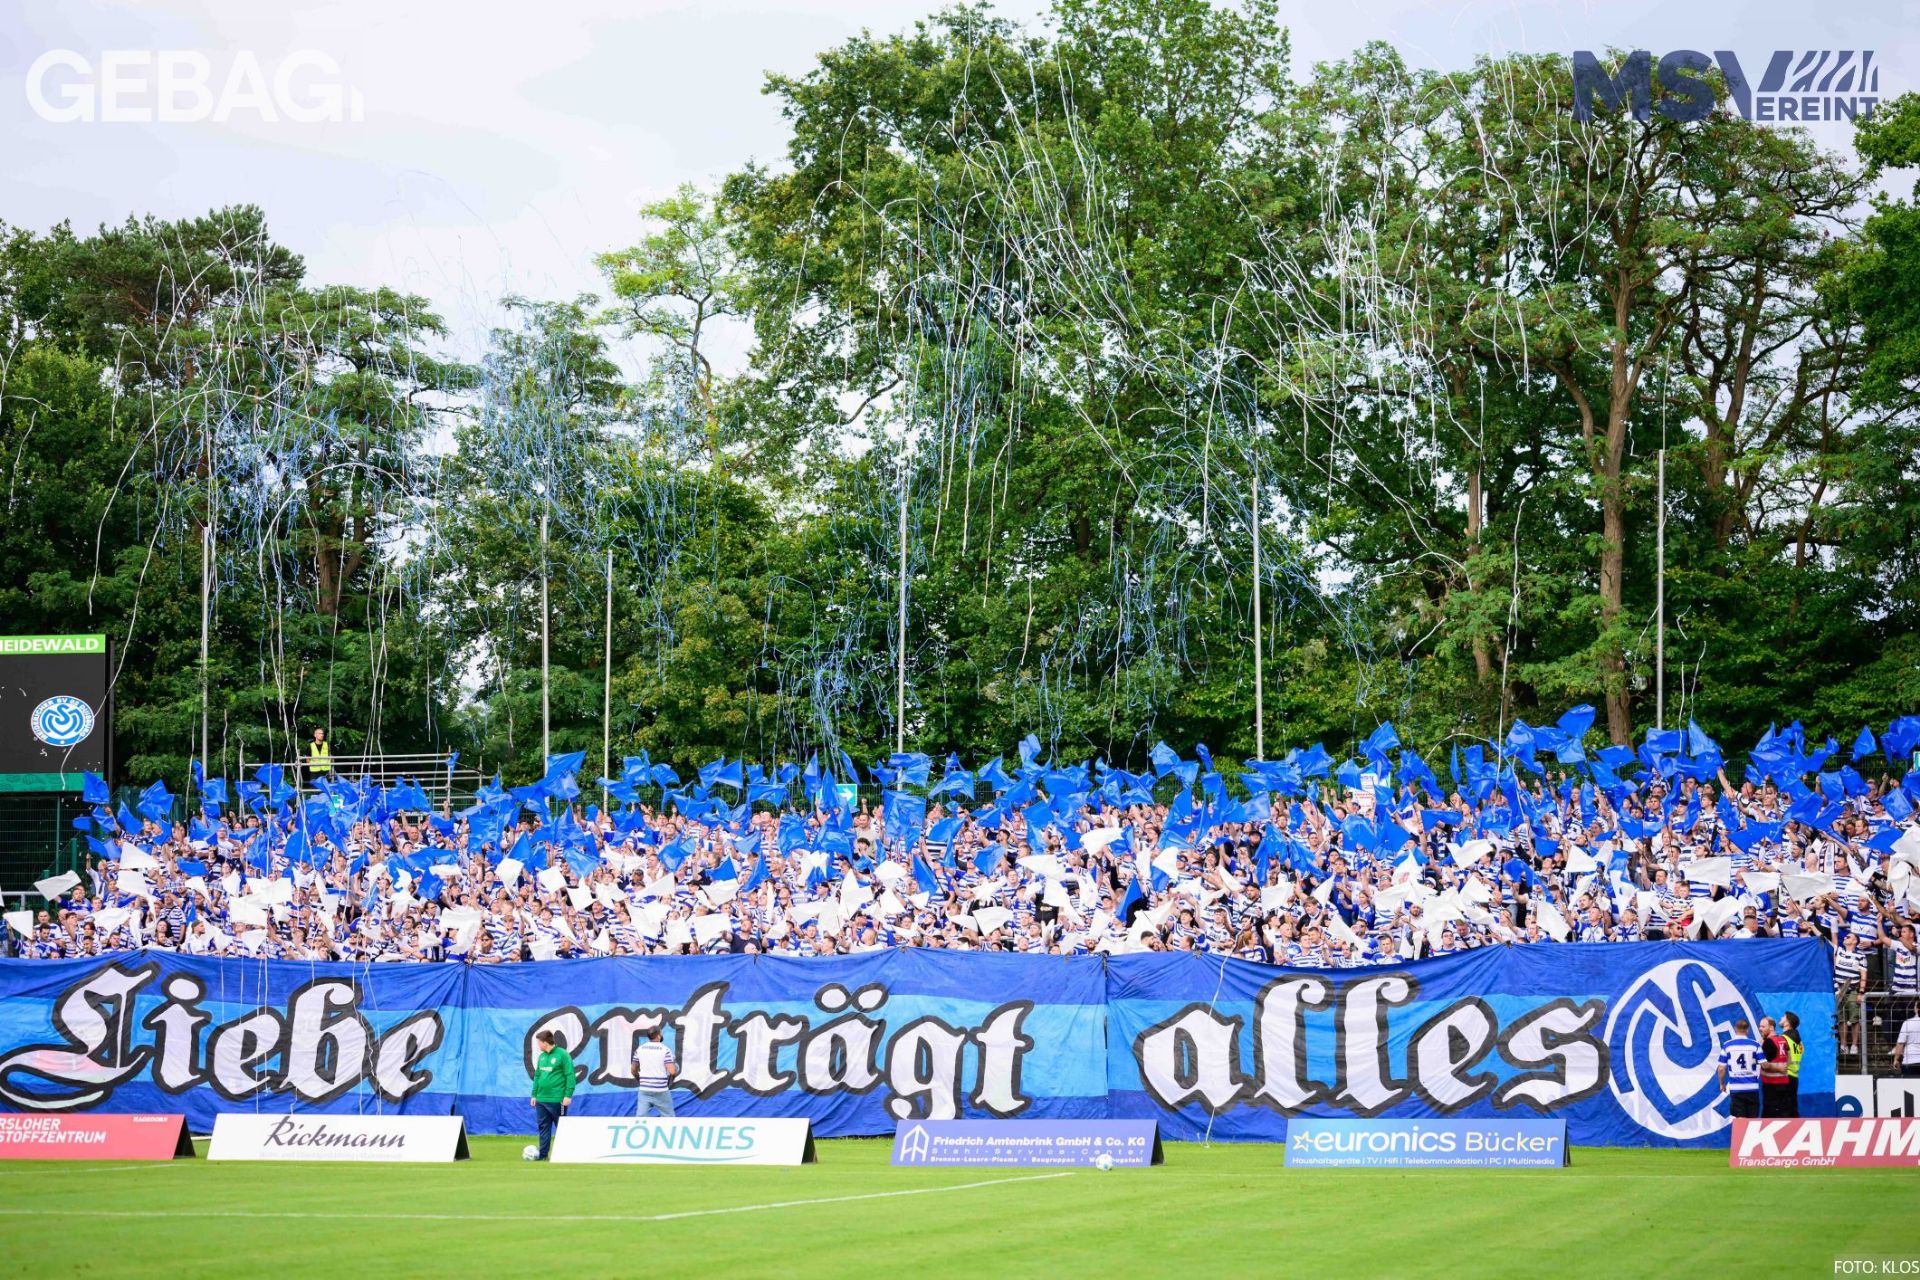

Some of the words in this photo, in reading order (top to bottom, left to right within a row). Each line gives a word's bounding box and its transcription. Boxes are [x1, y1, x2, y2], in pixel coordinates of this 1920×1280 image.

[0, 638, 99, 652] EIDEWALD
[0, 960, 445, 1112] Liebe
[523, 981, 1035, 1119] erträgt
[1133, 972, 1608, 1118] alles
[1736, 1053, 1747, 1069] 4
[263, 1115, 406, 1148] Rickmann
[606, 1120, 757, 1150] TÖNNIES
[933, 1136, 984, 1146] Friedrich
[986, 1136, 1053, 1146] Amtenbrink
[1056, 1136, 1091, 1146] GmbH
[1093, 1137, 1102, 1146] &
[1105, 1137, 1124, 1146] Co.
[1127, 1137, 1145, 1146] KG
[1314, 1125, 1457, 1152] euronics
[1465, 1131, 1559, 1152] Bücker
[1738, 1119, 1920, 1157] KAHM
[1292, 1157, 1361, 1166] Haushaltsgeräte
[1366, 1157, 1378, 1165] TV
[1404, 1157, 1483, 1165] Telekommunikation
[1738, 1157, 1799, 1168] TransCargo
[1801, 1157, 1836, 1166] GmbH
